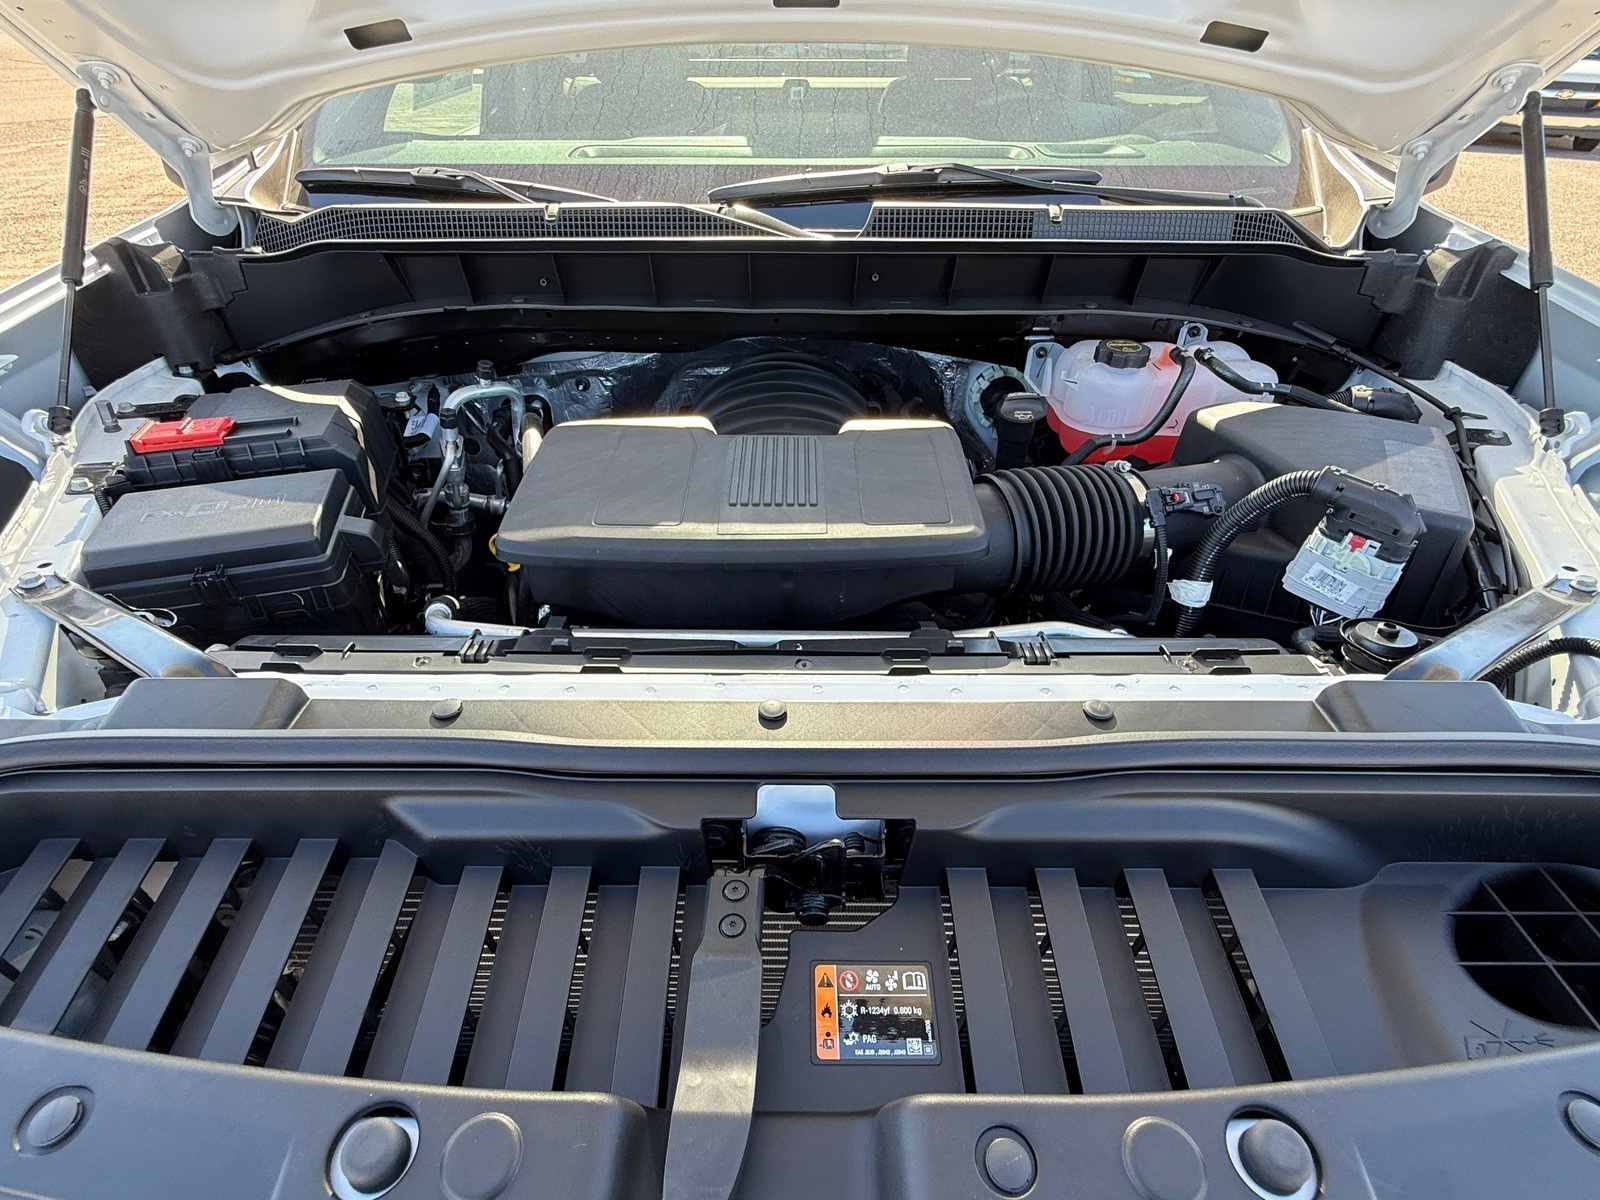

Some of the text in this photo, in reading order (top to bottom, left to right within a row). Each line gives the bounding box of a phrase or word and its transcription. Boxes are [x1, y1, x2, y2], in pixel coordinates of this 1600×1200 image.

[865, 983, 881, 991] AUTO
[860, 1006, 890, 1016] R-1234yf
[913, 1006, 922, 1016] kg
[862, 1034, 877, 1043] PAG
